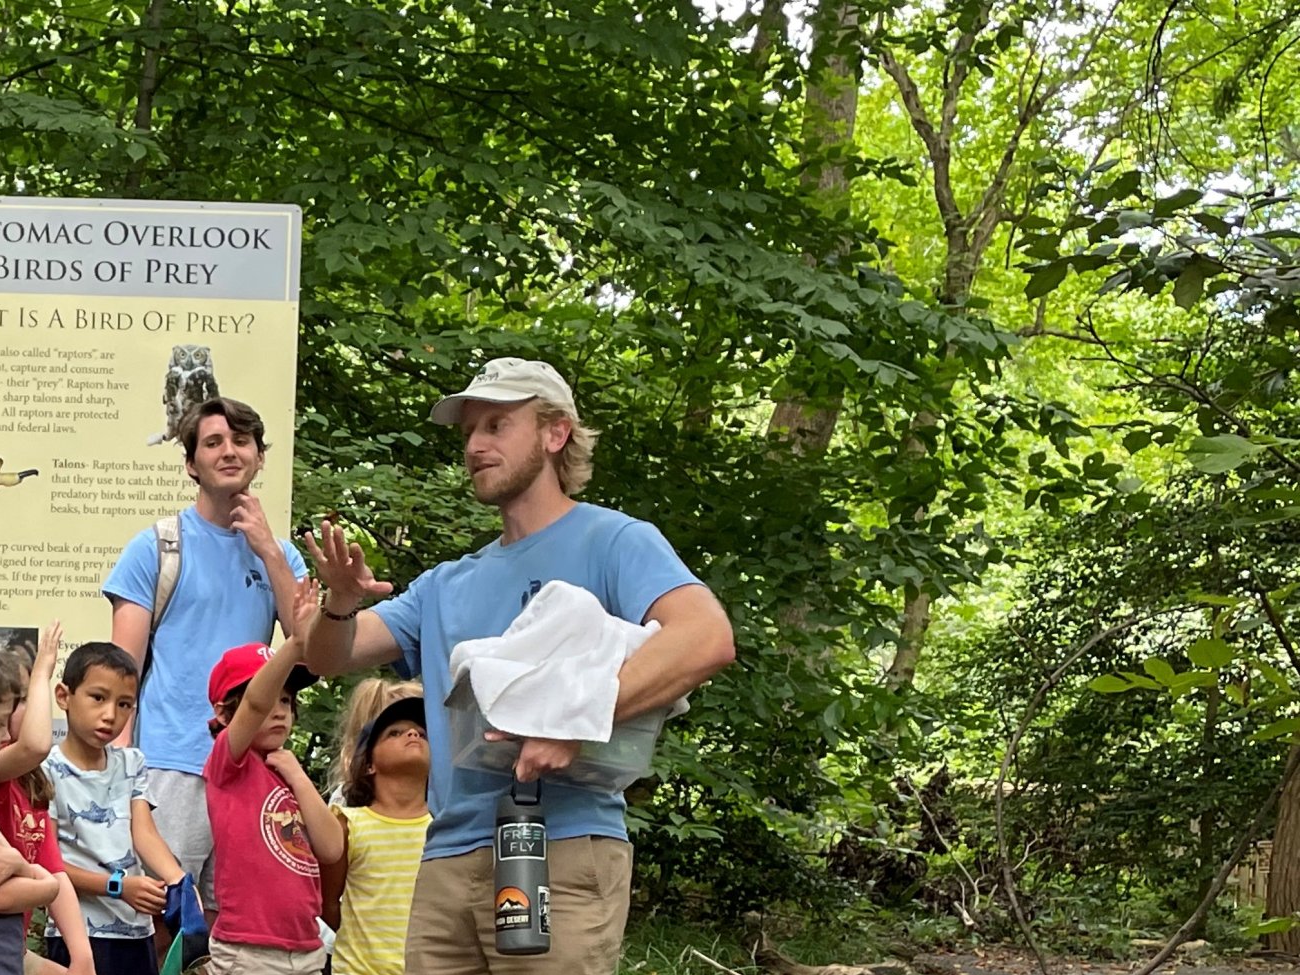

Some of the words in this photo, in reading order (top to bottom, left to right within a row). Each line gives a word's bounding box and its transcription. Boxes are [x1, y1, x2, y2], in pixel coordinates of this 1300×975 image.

[103, 220, 272, 250] OVERLOOK
[94, 260, 133, 283] OF
[146, 259, 219, 285] PREY
[19, 307, 38, 329] IS
[48, 309, 65, 329] A
[75, 309, 133, 330] BIRD
[143, 311, 176, 332] OF
[187, 312, 255, 334] PREY?
[0, 348, 20, 357] also
[22, 348, 50, 358] called
[10, 364, 47, 375] capture
[49, 363, 67, 373] and
[70, 366, 115, 374] consume
[7, 378, 30, 387] their
[67, 379, 104, 391] Raptors
[106, 379, 130, 390] have
[3, 392, 30, 404] sharp
[33, 393, 63, 403] talons
[65, 393, 83, 404] and
[1, 407, 15, 417] All
[19, 409, 53, 419] raptors
[73, 409, 119, 420] protected
[17, 422, 50, 432] federal
[92, 459, 130, 472] Raptors
[133, 459, 155, 471] have
[158, 461, 184, 473] sharp
[52, 474, 70, 483] that
[73, 474, 95, 485] they
[97, 476, 113, 485] use
[116, 476, 125, 485] to
[128, 475, 154, 486] catch
[156, 476, 179, 487] their
[182, 479, 198, 489] pre
[51, 490, 98, 501] predatory
[101, 490, 125, 500] birds
[128, 490, 146, 501] will
[148, 491, 174, 501] catch
[83, 504, 99, 514] but
[102, 506, 136, 517] raptors
[139, 507, 155, 516] use
[11, 542, 44, 552] curved
[47, 542, 70, 553] beak
[73, 543, 84, 553] of
[93, 545, 123, 557] raptor
[29, 558, 43, 567] for
[46, 559, 80, 571] tearing
[82, 561, 104, 571] prey
[12, 572, 20, 581] If
[23, 572, 37, 582] the
[40, 575, 61, 585] prey
[64, 574, 73, 583] is
[75, 574, 100, 583] small
[0, 587, 33, 598] raptors
[36, 588, 65, 599] prefer
[67, 589, 77, 597] to
[503, 829, 541, 840] FREE
[510, 842, 535, 852] FLY
